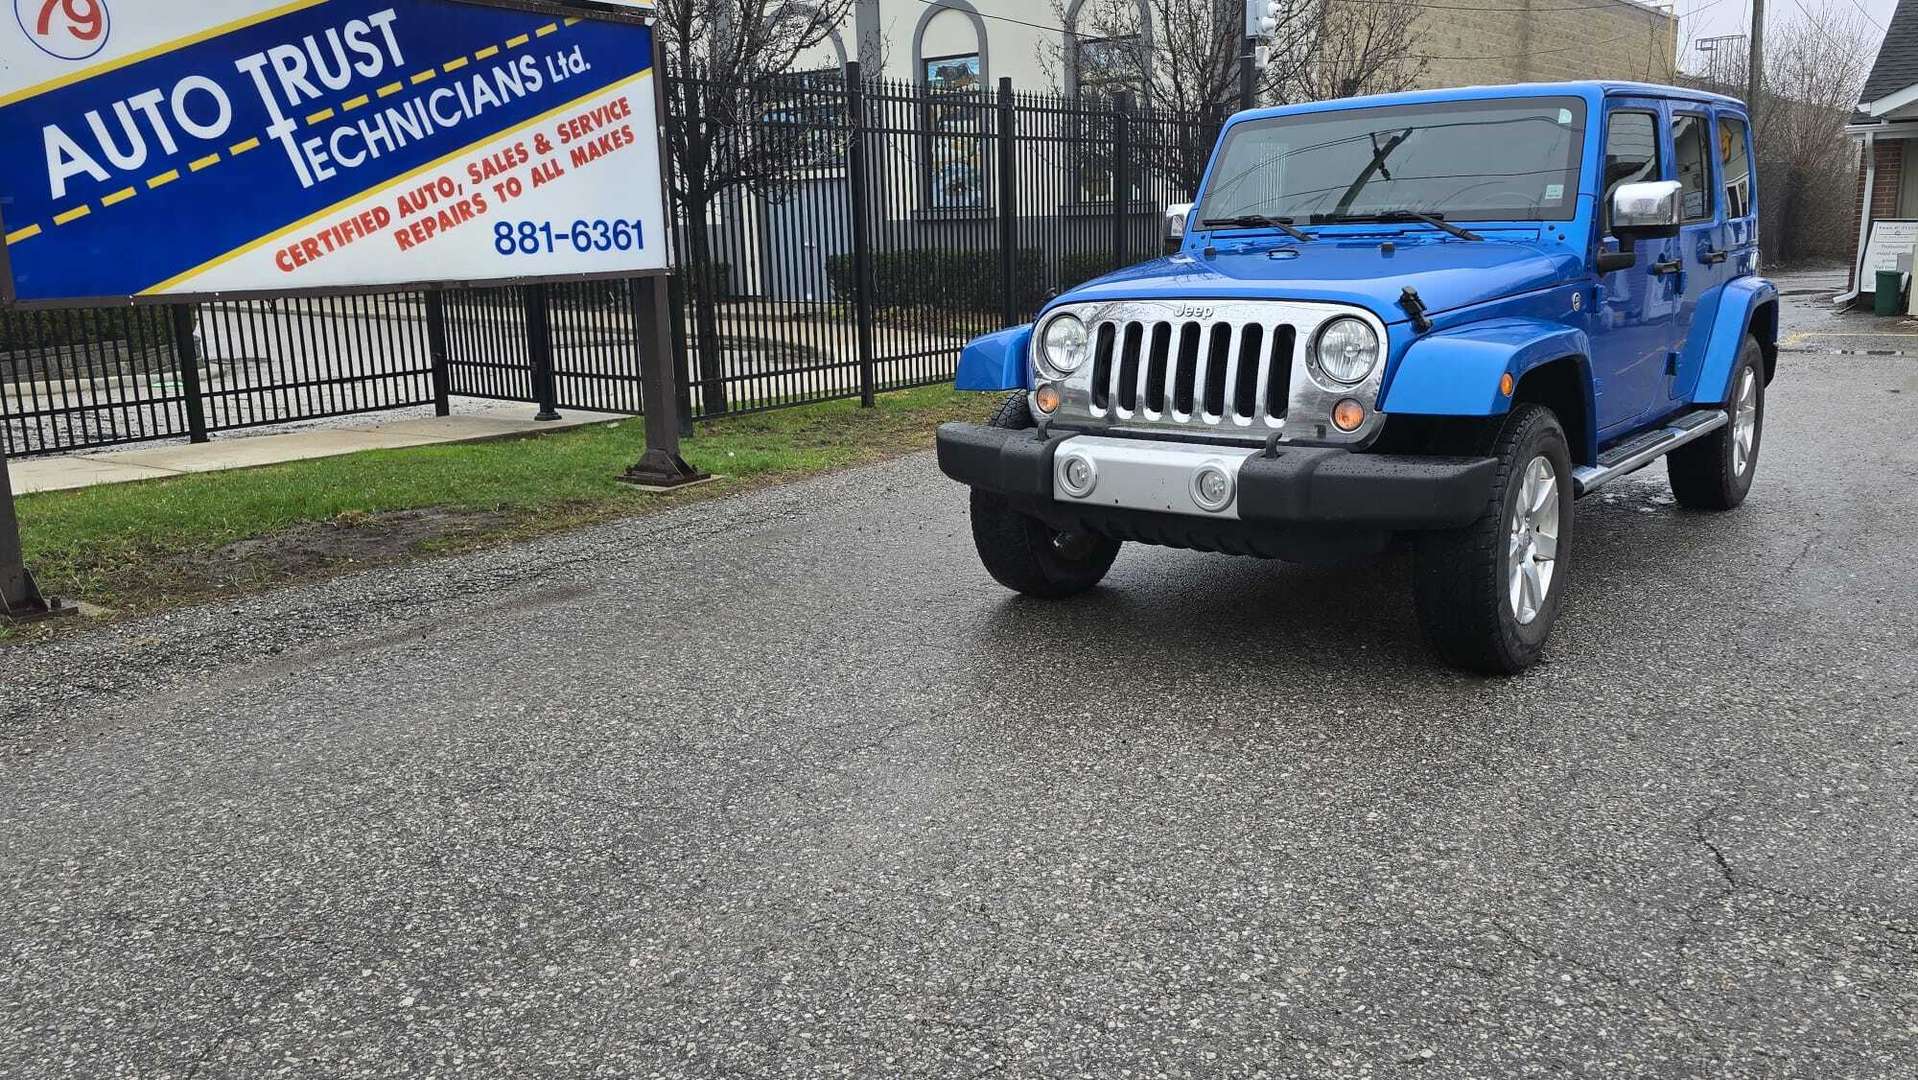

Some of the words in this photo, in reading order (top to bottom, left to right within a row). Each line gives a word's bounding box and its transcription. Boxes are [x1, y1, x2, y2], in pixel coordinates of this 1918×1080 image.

[42, 75, 233, 199] AUTO
[234, 8, 405, 124] TRUST
[266, 54, 544, 189] TECHNICIANS
[550, 45, 592, 85] Ltd.
[275, 206, 391, 273] CERTIFIED
[397, 176, 463, 218] AUTO,
[467, 142, 529, 185] SALES
[534, 132, 553, 155] &
[557, 97, 632, 144] SERVICE
[394, 193, 488, 251] REPAIRS
[493, 177, 522, 203] TO
[531, 160, 565, 188] ALL
[570, 125, 635, 169] MAKES
[493, 218, 644, 256] 881-6361
[1173, 304, 1215, 320] Jeep
